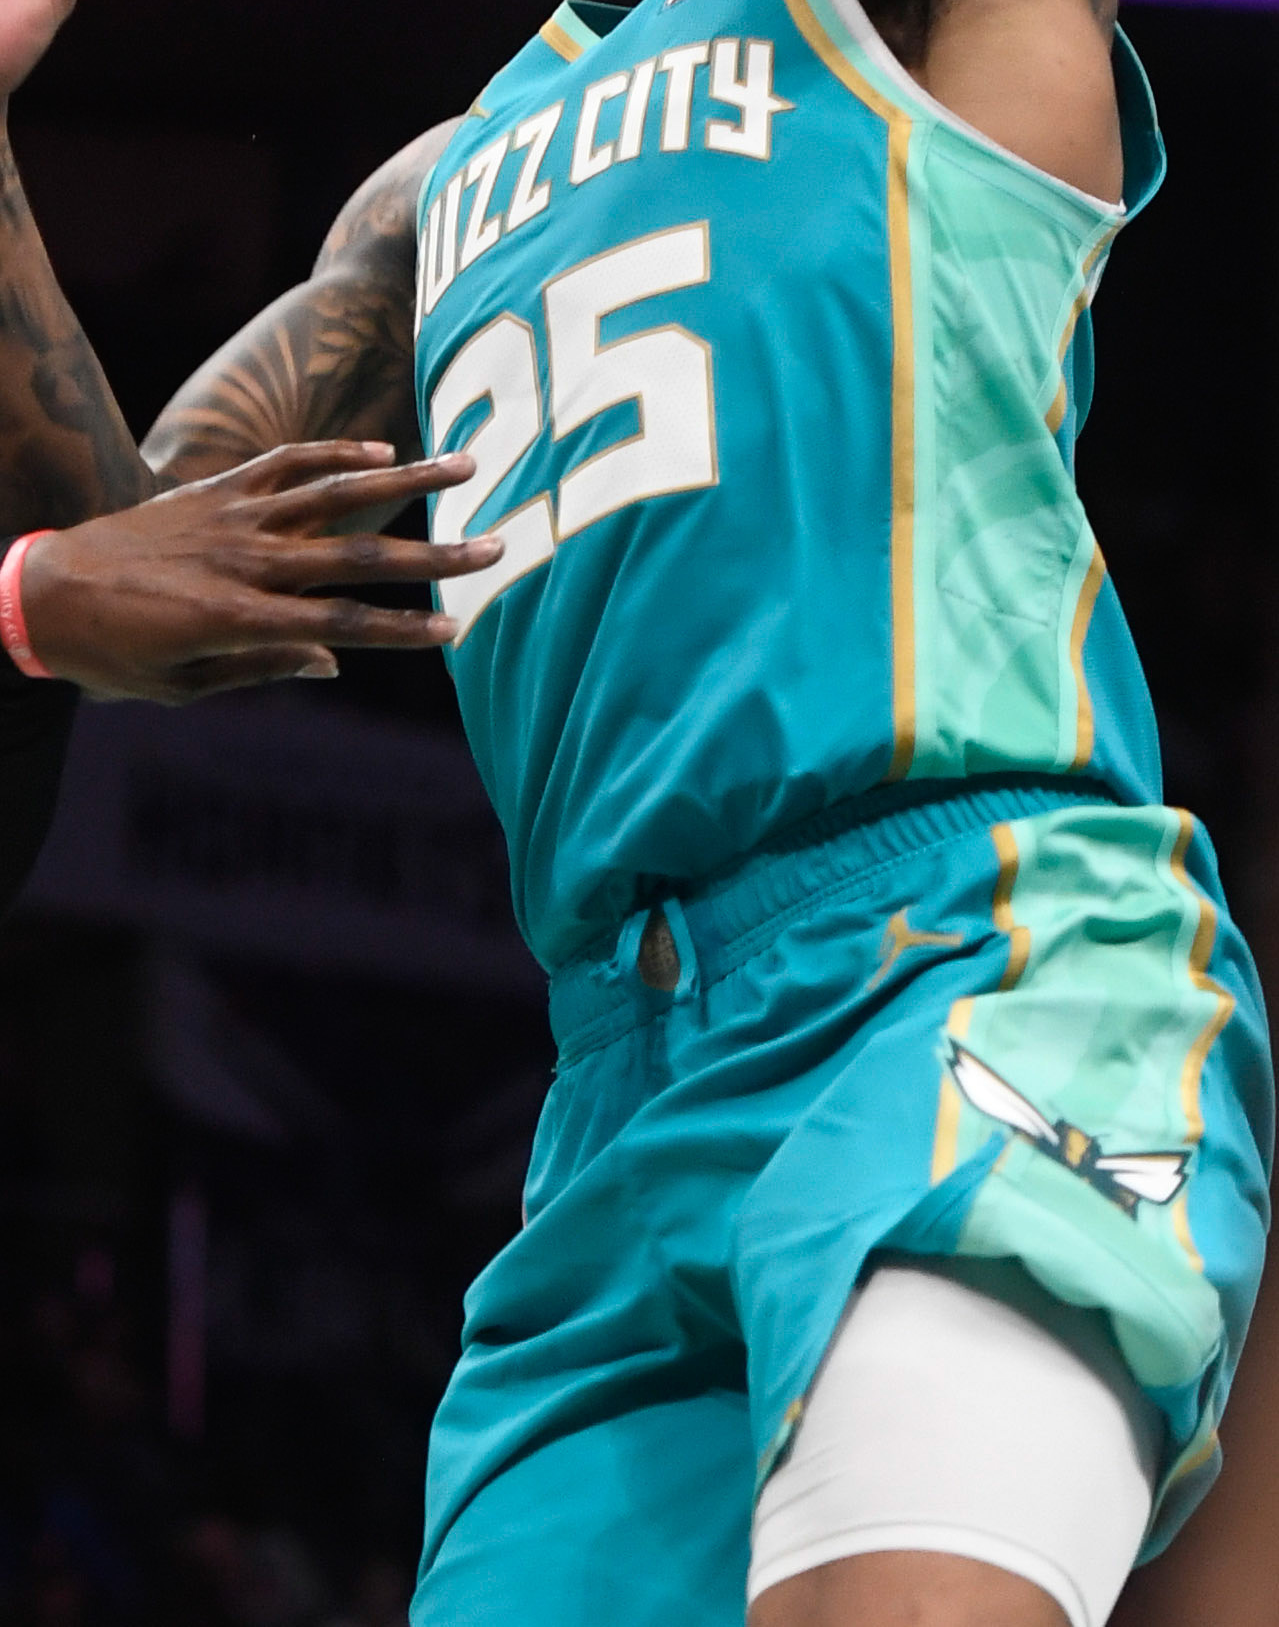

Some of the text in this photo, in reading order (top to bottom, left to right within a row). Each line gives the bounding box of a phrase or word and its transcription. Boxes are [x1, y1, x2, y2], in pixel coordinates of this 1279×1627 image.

[414, 37, 796, 342] UZZ CITY
[430, 220, 719, 650] 25
